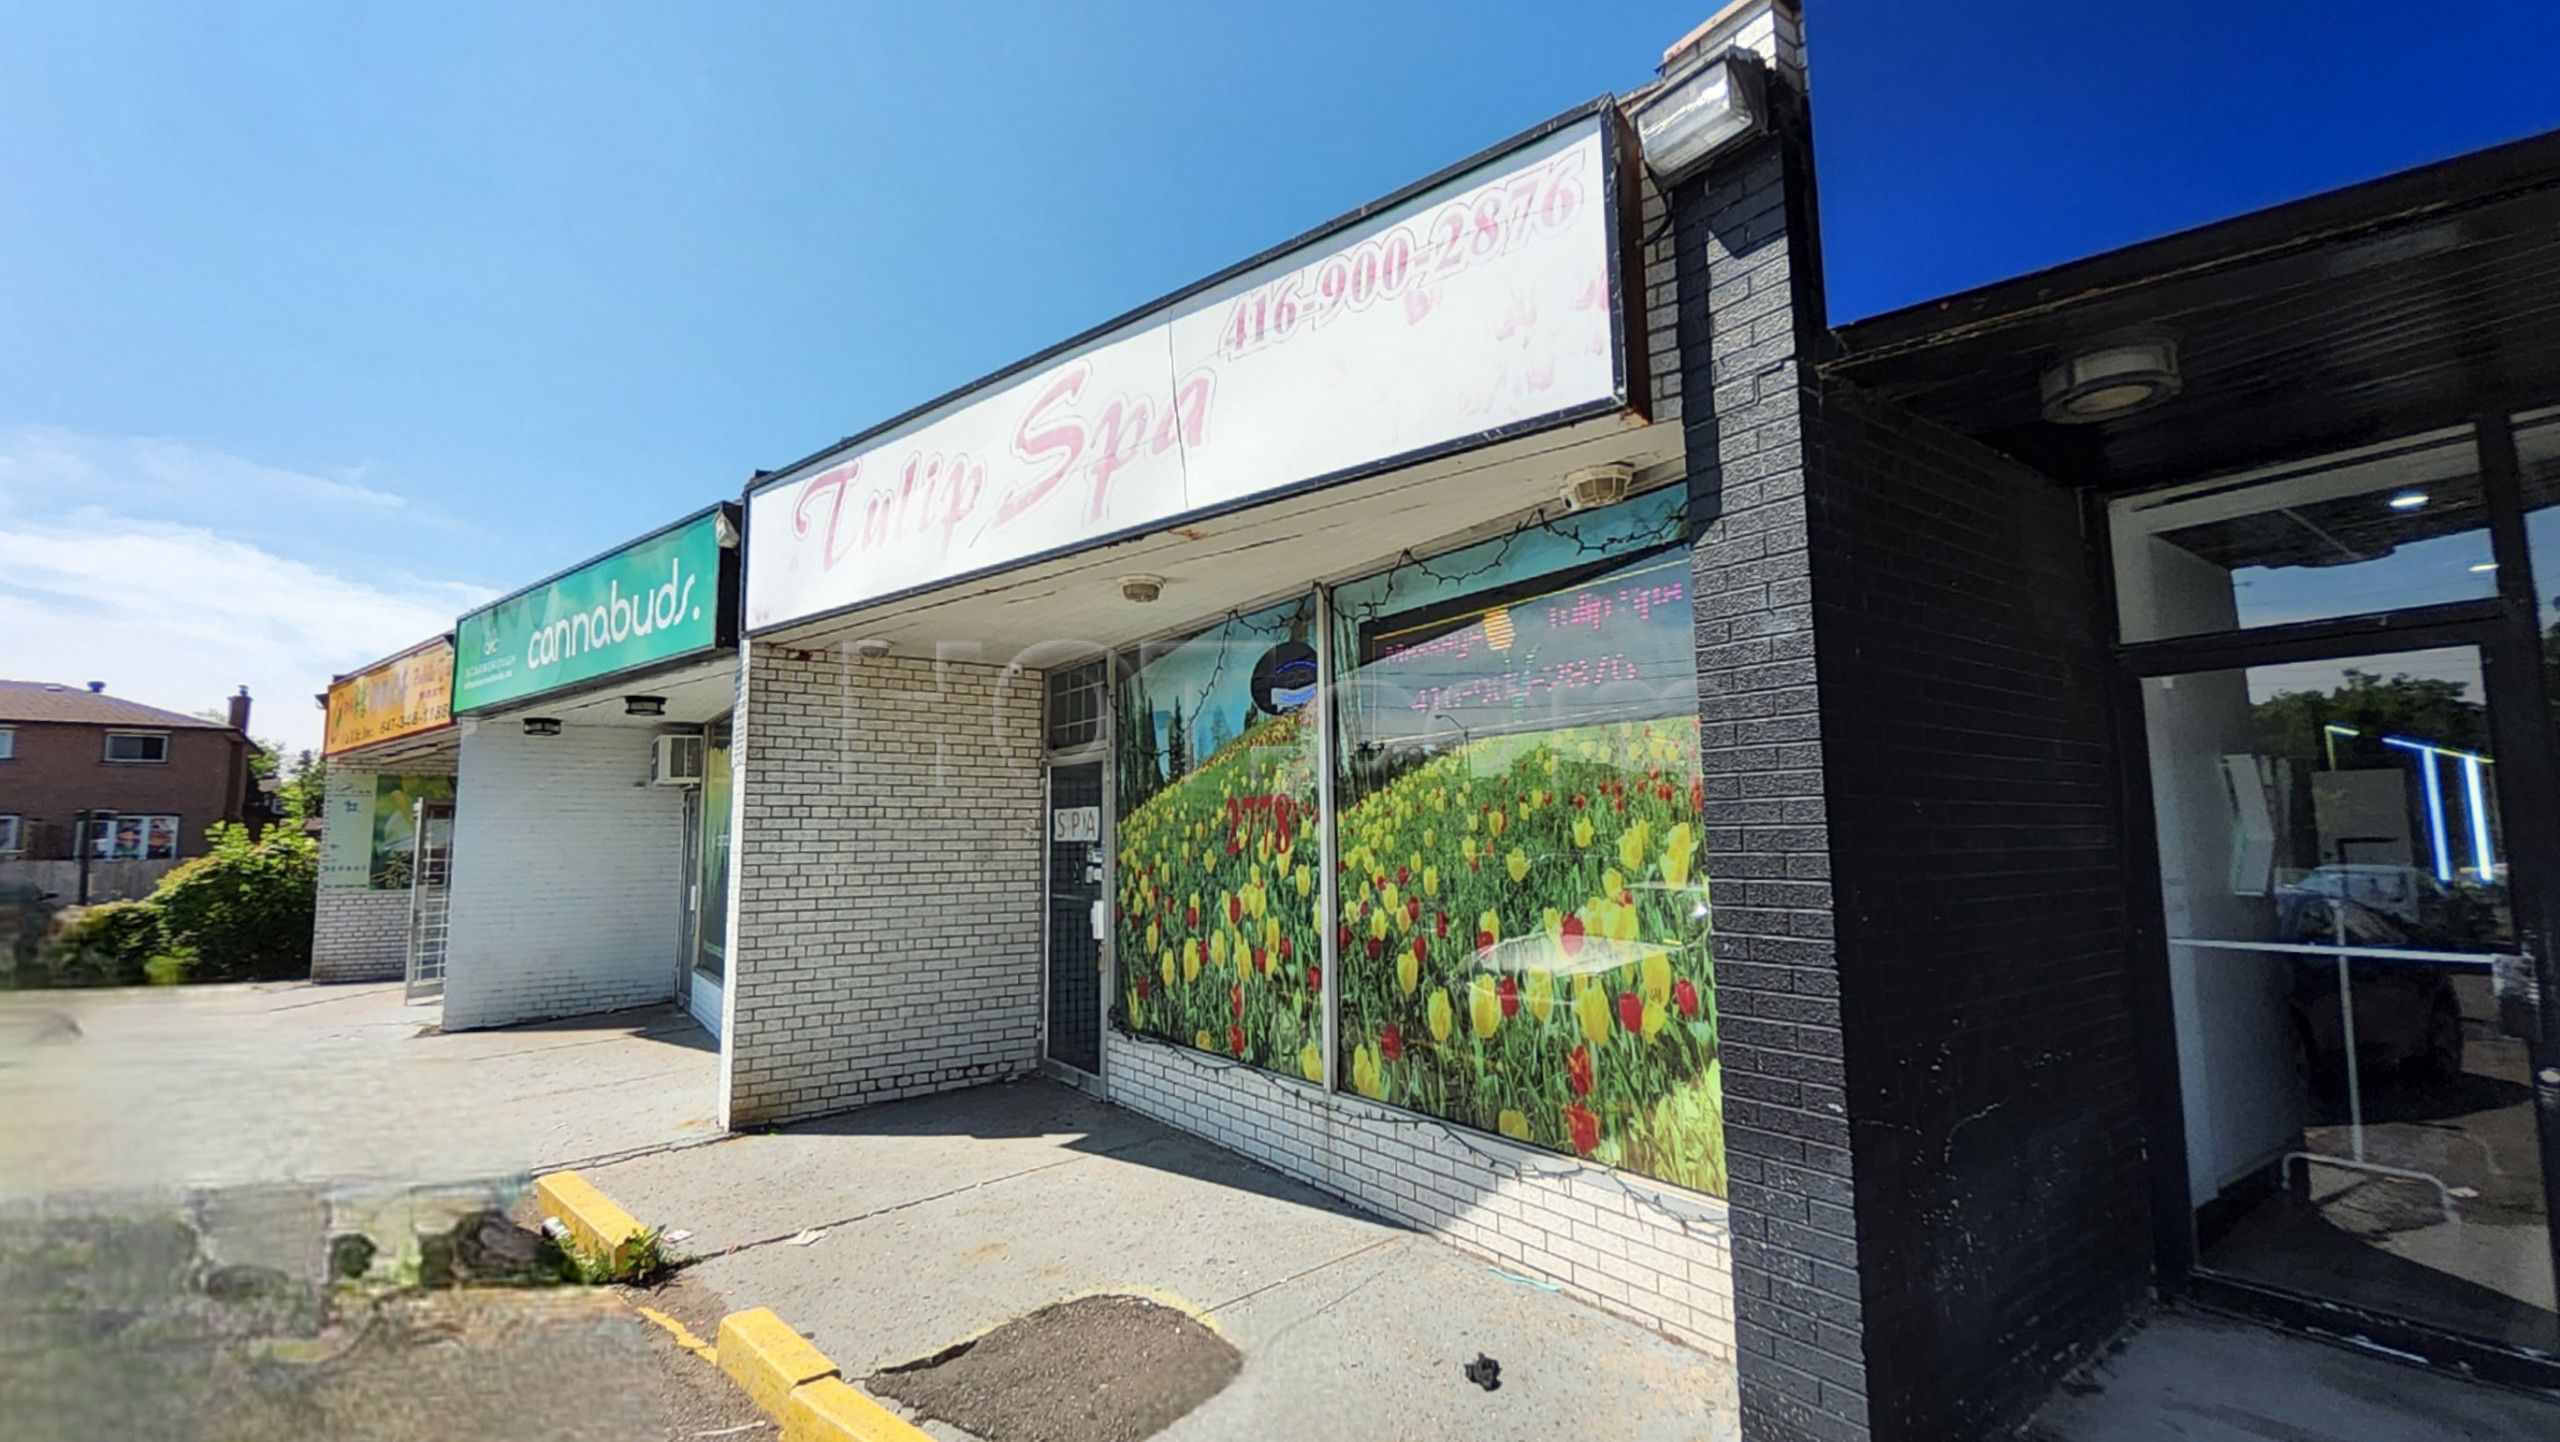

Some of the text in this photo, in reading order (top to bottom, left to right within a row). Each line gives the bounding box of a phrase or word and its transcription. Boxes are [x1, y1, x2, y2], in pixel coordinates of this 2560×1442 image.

[1222, 152, 1584, 358] 416-900-2876
[795, 360, 1215, 571] Tulip Spa
[1057, 811, 1096, 839] SPA
